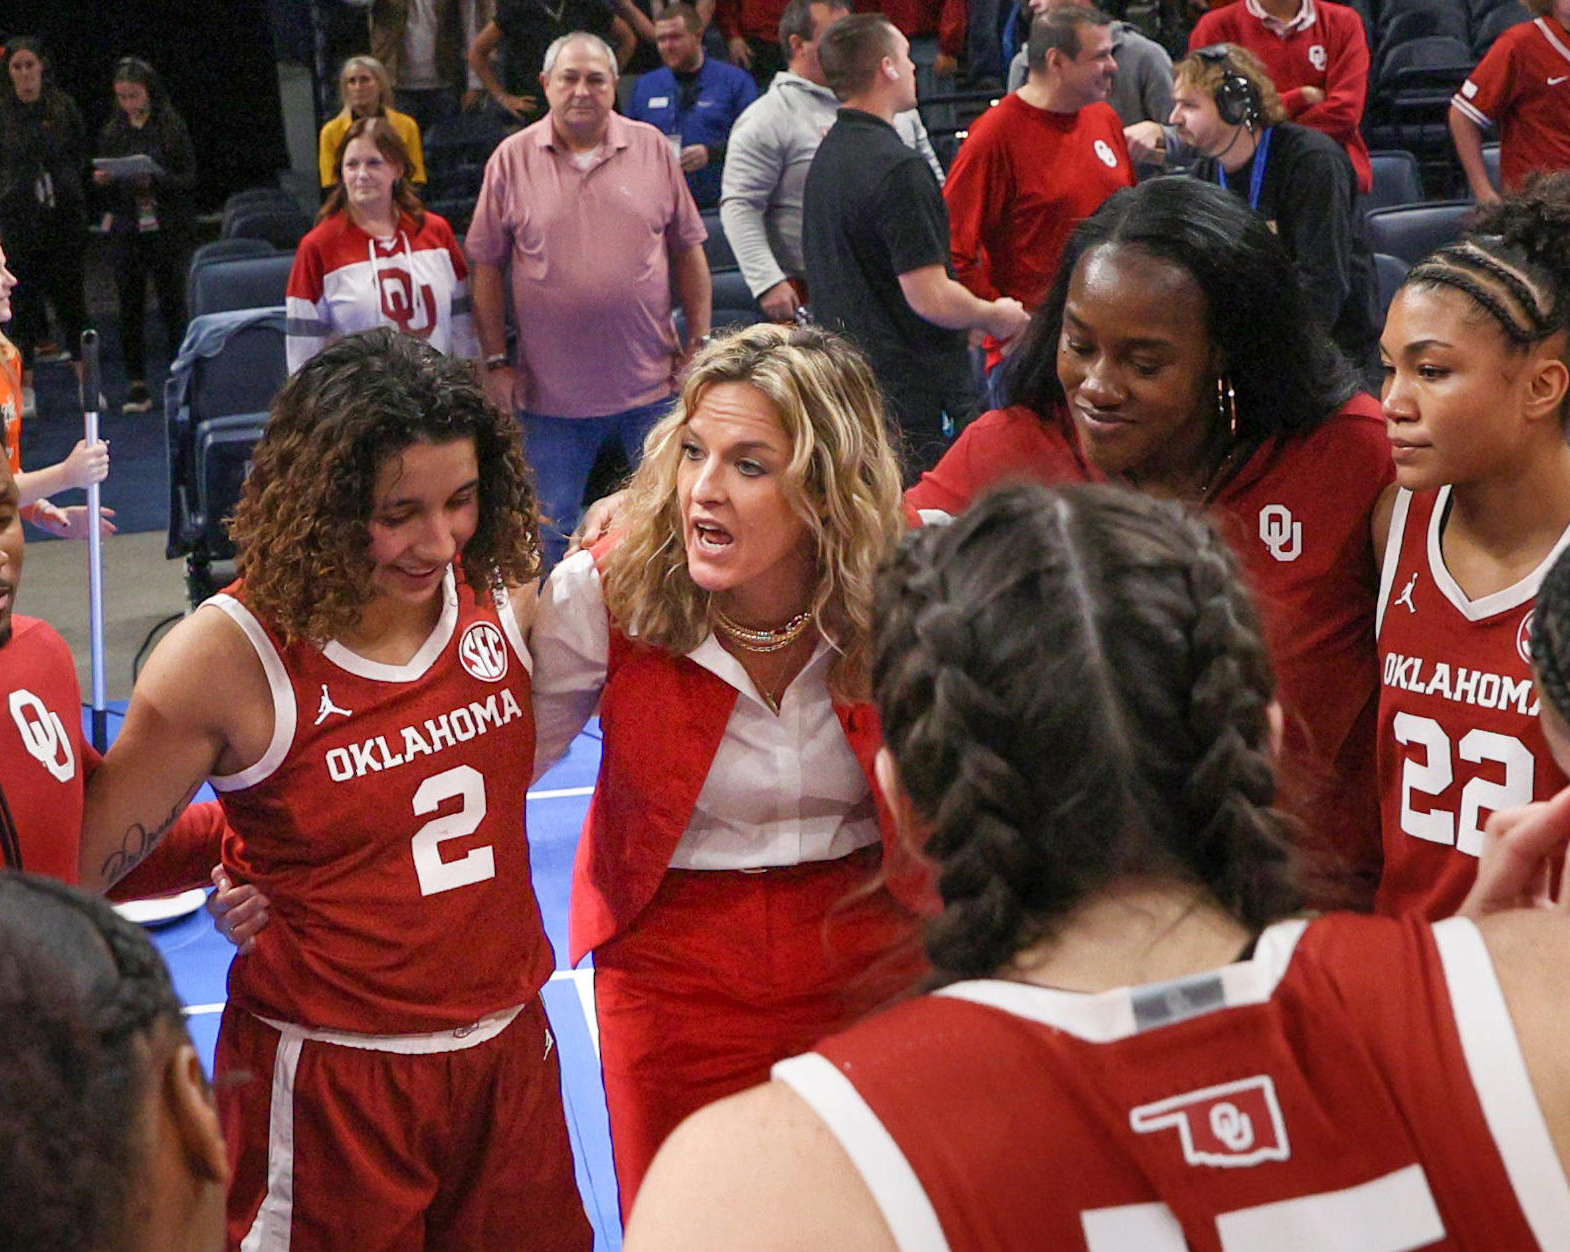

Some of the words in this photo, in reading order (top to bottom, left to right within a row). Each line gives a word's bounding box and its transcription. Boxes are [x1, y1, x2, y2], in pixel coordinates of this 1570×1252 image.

[377, 266, 437, 341] OU
[1258, 504, 1303, 562] OU
[463, 626, 505, 678] SEC
[8, 688, 76, 783] OU
[325, 688, 523, 784] OKLAHOMA
[1392, 710, 1535, 858] 22
[410, 763, 496, 897] 2
[1209, 1103, 1253, 1151] OU
